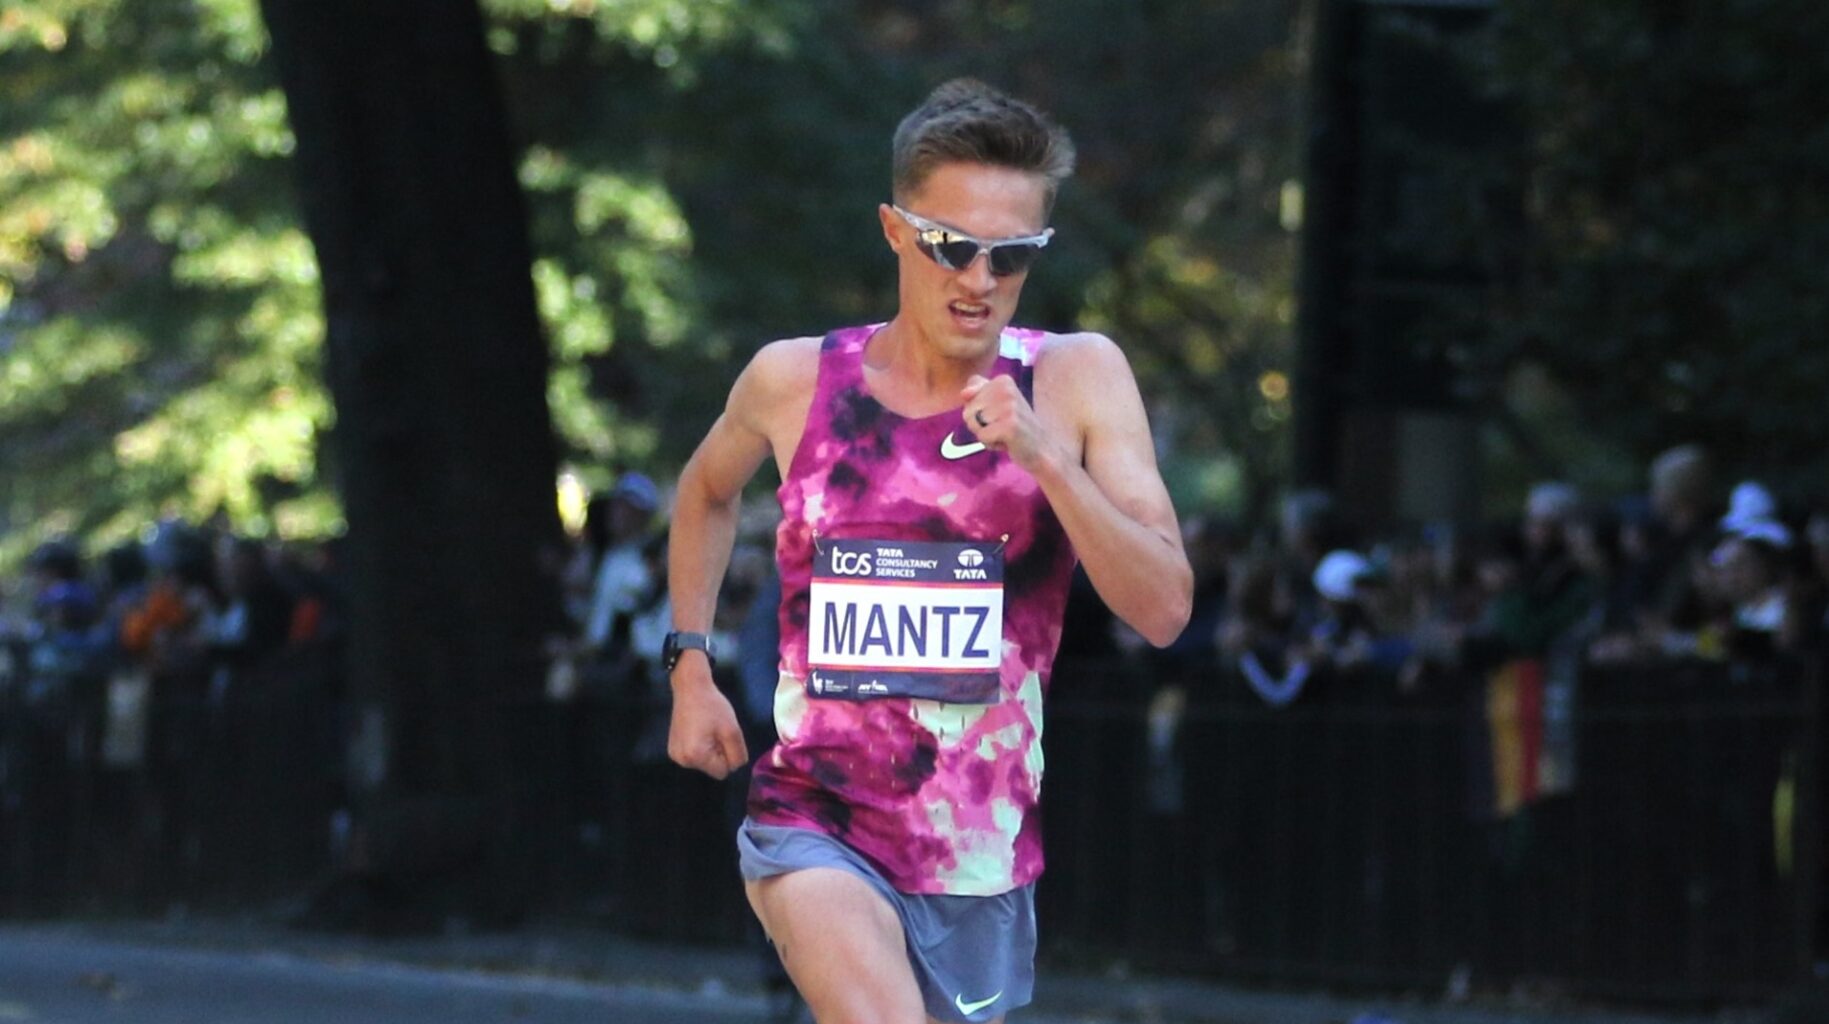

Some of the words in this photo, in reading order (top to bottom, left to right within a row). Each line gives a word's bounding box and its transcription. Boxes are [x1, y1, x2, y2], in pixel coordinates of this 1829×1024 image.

[876, 548, 904, 558] TATA
[831, 546, 872, 576] tcs
[876, 557, 938, 569] CONSULTANCY
[875, 567, 916, 578] SERVICES
[953, 568, 987, 580] TATA
[822, 601, 991, 659] MANTZ
